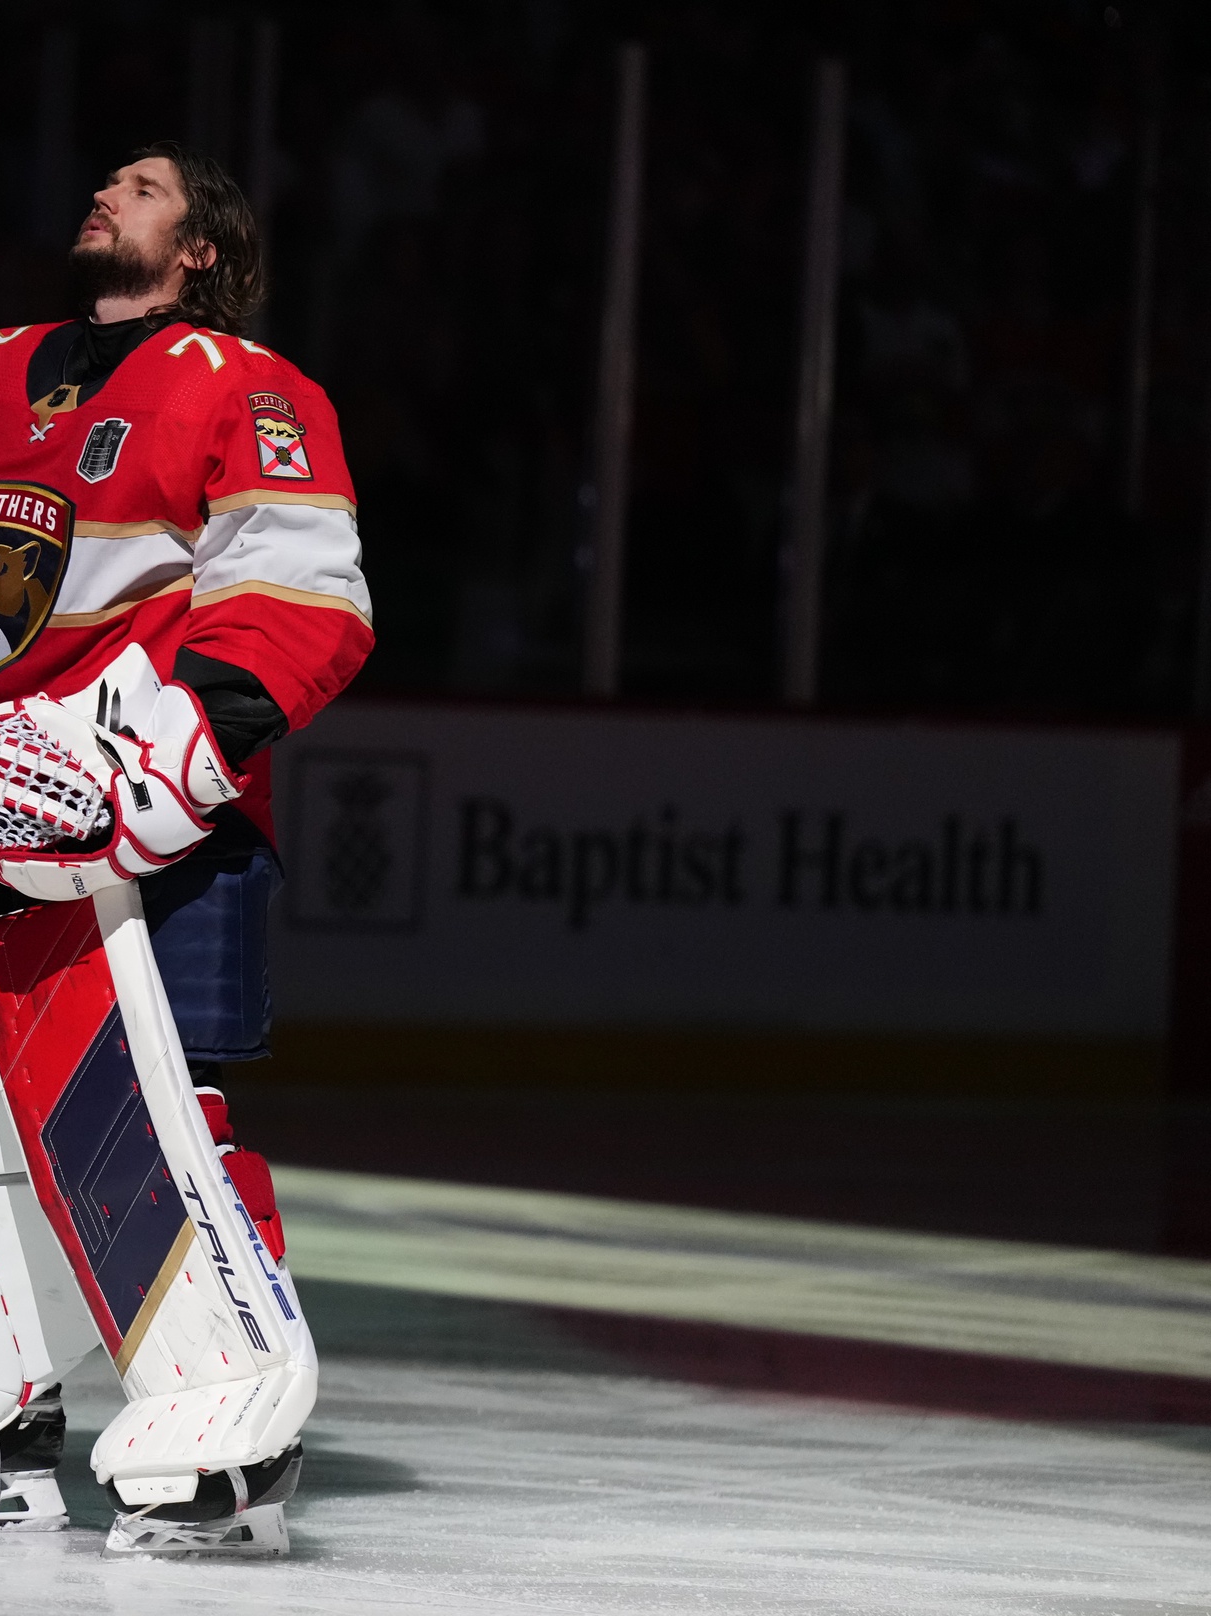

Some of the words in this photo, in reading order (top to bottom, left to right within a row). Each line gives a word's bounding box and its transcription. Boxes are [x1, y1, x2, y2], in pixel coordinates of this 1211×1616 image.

[254, 397, 289, 411] FLORIDA
[454, 796, 746, 930] Baptist
[774, 808, 1046, 916] Health
[184, 1171, 271, 1353] TRUE
[218, 1155, 297, 1321] TRUE
